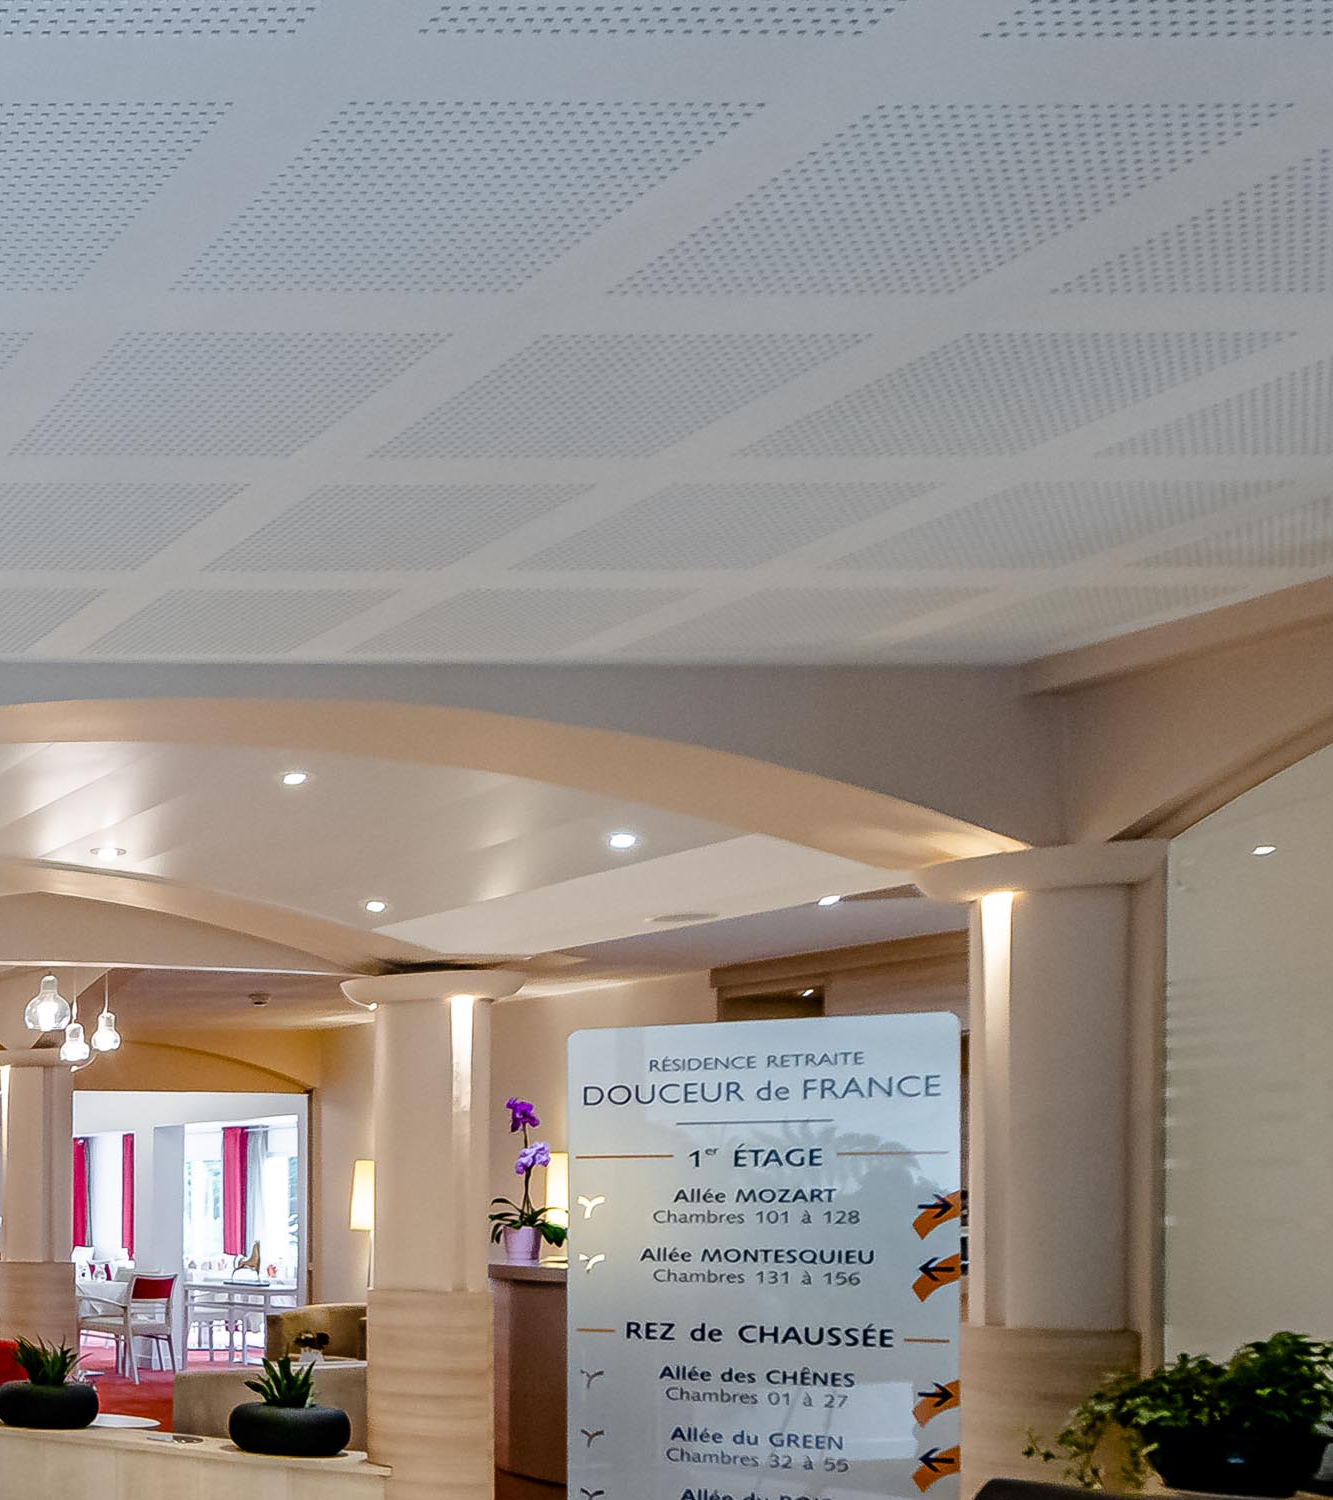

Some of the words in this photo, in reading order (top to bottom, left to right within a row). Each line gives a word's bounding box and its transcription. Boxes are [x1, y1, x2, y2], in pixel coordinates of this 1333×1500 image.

[649, 1056, 756, 1072] RÉSIDENCE
[767, 1051, 864, 1068] RETRAITE
[584, 1082, 744, 1106] DOUCEUR
[757, 1080, 789, 1101] de
[803, 1075, 941, 1100] FRANCE
[734, 1143, 822, 1167] ÉTAGE
[674, 1188, 726, 1203] Allée
[736, 1189, 836, 1203] MOZART
[653, 1209, 745, 1224] Chambres
[756, 1210, 788, 1224] 101
[801, 1210, 812, 1224] à
[823, 1210, 860, 1224] 128
[640, 1247, 691, 1262] Allée
[701, 1249, 874, 1264] MONTESQUIEU
[653, 1268, 745, 1286] Chambres
[756, 1271, 788, 1284] 131
[801, 1270, 811, 1285] à
[824, 1270, 861, 1286] 156
[626, 1322, 675, 1340] REZ
[690, 1323, 723, 1342] de
[738, 1323, 893, 1348] CHAUSSÉE
[659, 1365, 712, 1382] Allée
[721, 1368, 756, 1383] des
[766, 1367, 855, 1387] CHÊNES
[666, 1386, 758, 1405] Chambres
[768, 1391, 789, 1405] 01
[803, 1390, 813, 1407] à
[824, 1394, 848, 1411] 27
[671, 1427, 723, 1444] Allée
[733, 1430, 758, 1446] du
[769, 1432, 843, 1450] GREEN
[666, 1446, 761, 1469] Chambres
[770, 1453, 792, 1469] 32
[803, 1455, 813, 1470] à
[823, 1457, 850, 1472] 55
